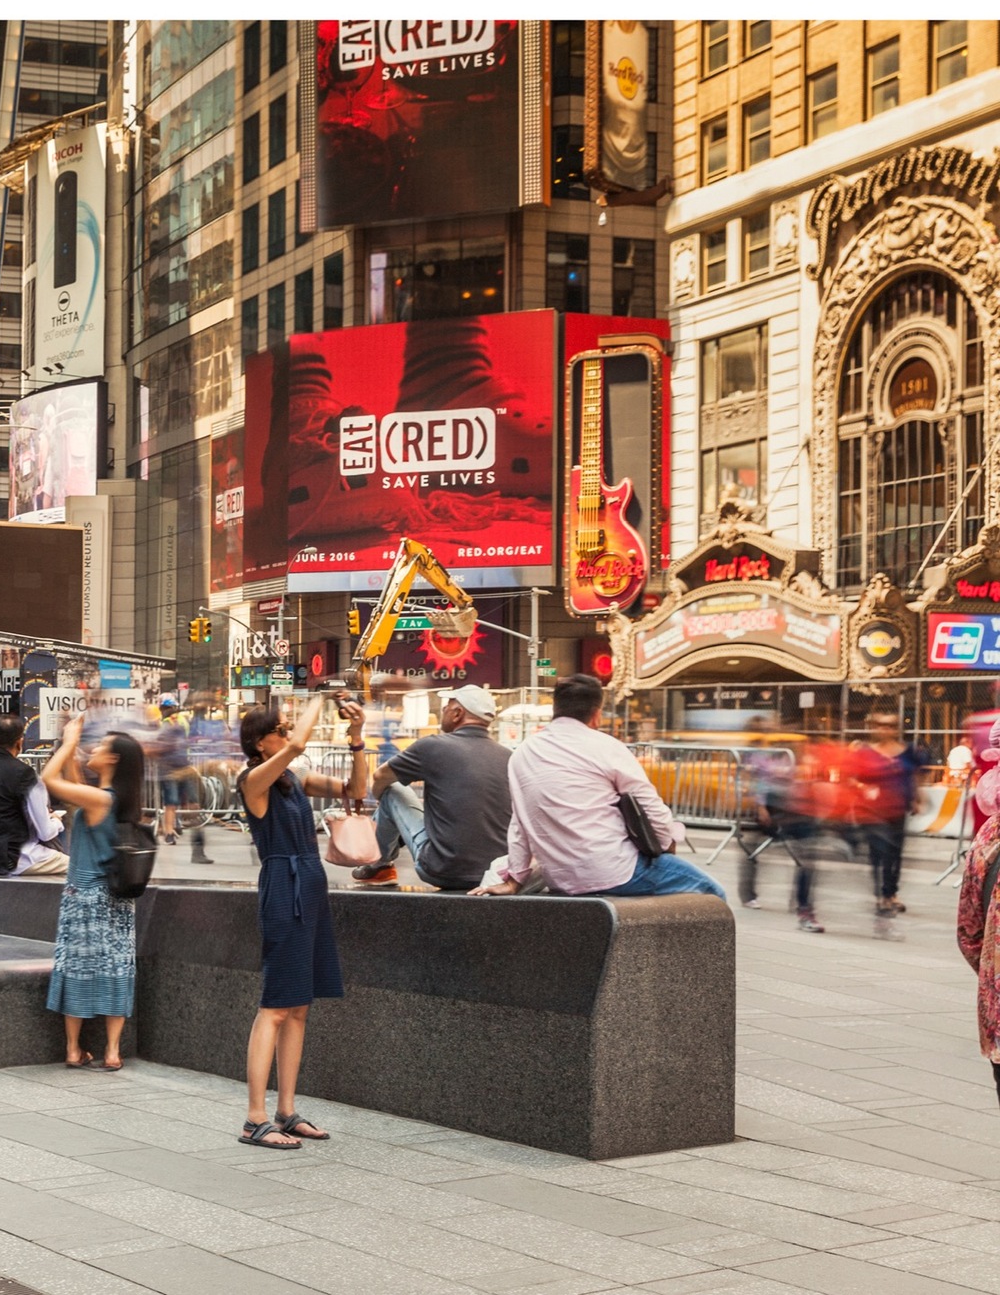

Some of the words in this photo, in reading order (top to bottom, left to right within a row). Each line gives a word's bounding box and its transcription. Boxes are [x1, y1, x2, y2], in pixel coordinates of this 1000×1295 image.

[381, 60, 430, 80] SAVE
[439, 52, 496, 73] LIVES
[51, 310, 80, 328] THETA
[382, 474, 430, 489] SAVE
[440, 471, 496, 487] LIVES
[295, 552, 327, 563] JUNE
[329, 552, 356, 562] 2016
[458, 545, 543, 558] RED.ORG/EAT
[576, 560, 611, 578] Hard
[611, 560, 645, 580] Rock
[704, 557, 737, 582] Hard
[738, 554, 771, 582] Rock
[401, 619, 407, 628] 7
[410, 619, 423, 628] Av
